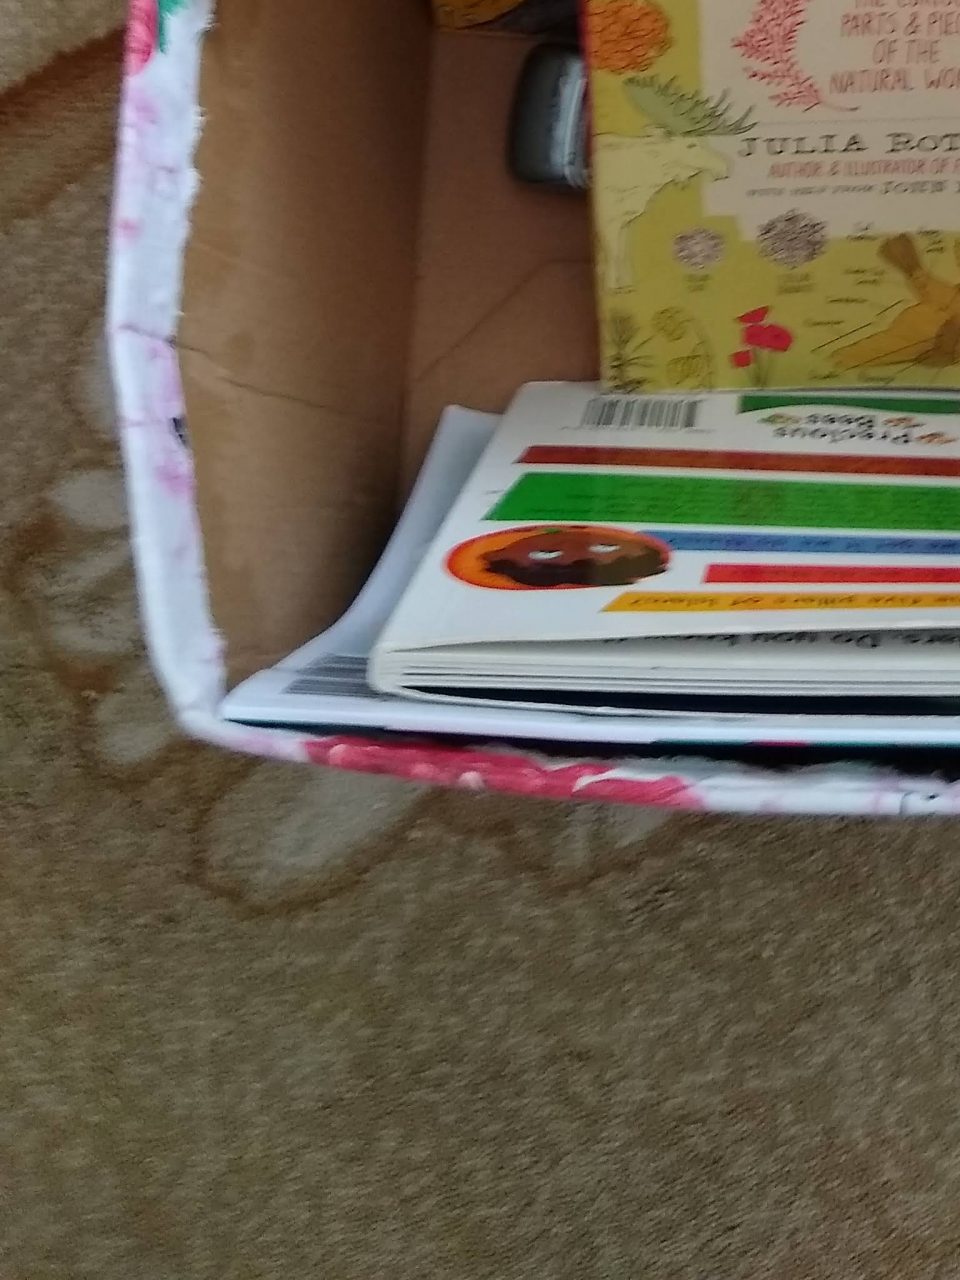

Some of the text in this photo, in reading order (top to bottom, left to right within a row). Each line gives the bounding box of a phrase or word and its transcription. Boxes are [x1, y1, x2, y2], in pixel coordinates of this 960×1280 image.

[841, 11, 898, 37] PARTS
[903, 11, 920, 36] &
[873, 39, 942, 64] OF THE
[830, 68, 914, 94] NATURAL
[738, 134, 869, 157] JULIA
[769, 160, 824, 178] AUTHOR
[845, 158, 926, 176] ILLUSTRATOR
[832, 632, 881, 650] Do
